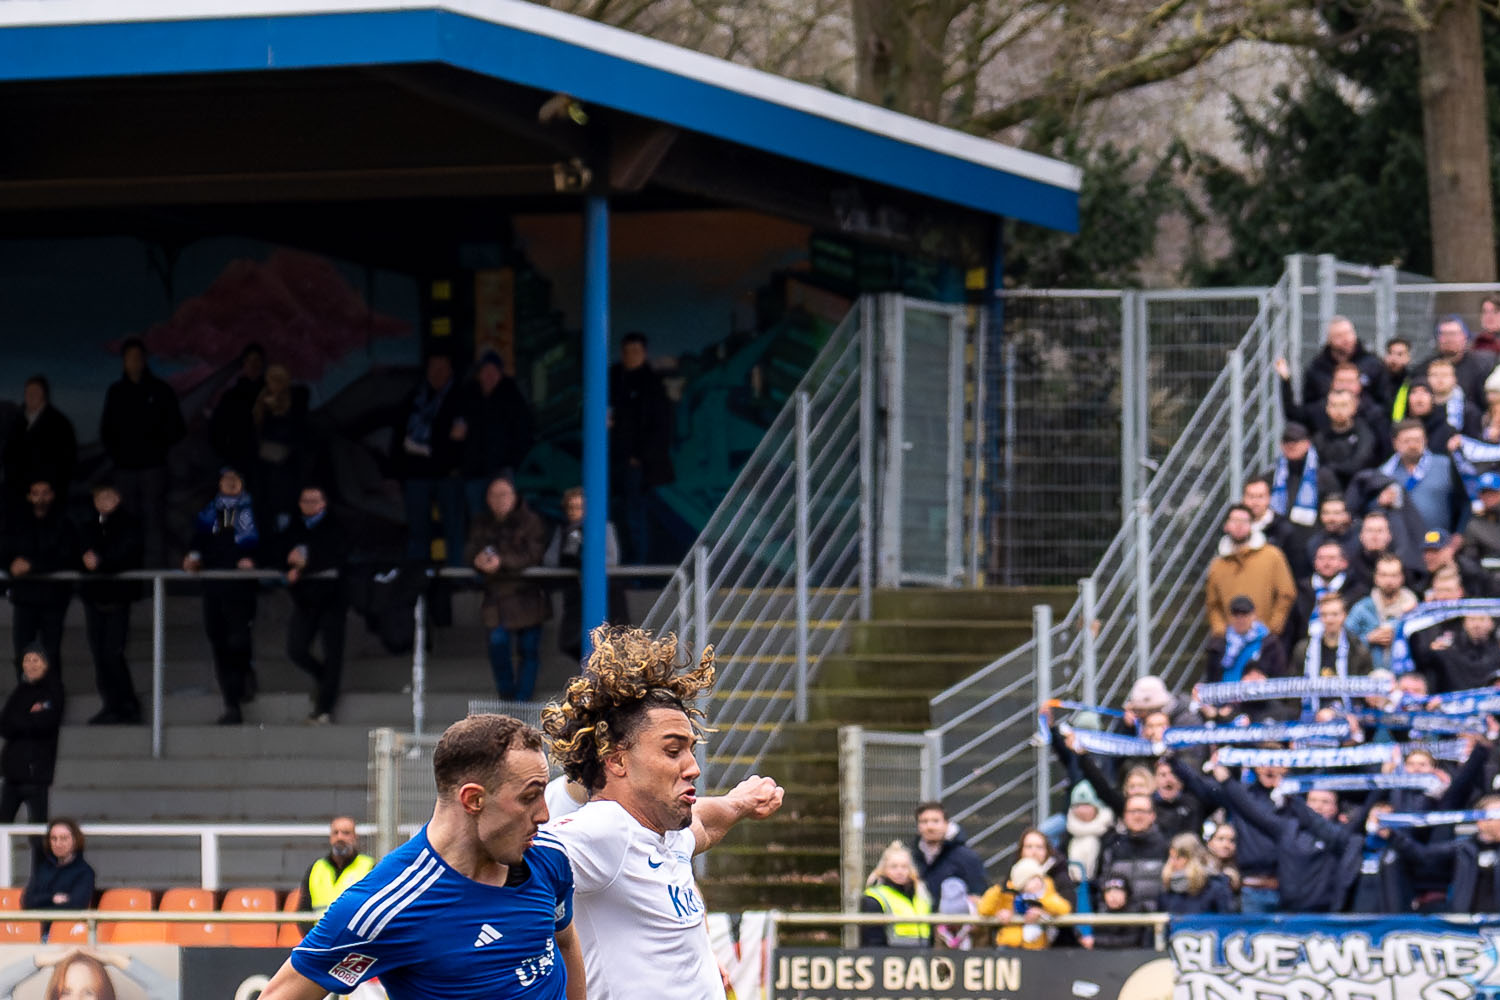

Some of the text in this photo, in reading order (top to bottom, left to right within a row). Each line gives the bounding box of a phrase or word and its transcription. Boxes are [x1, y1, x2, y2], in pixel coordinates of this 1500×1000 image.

[331, 967, 357, 984] NORD
[775, 956, 1021, 991] JEDES BAD EIN
